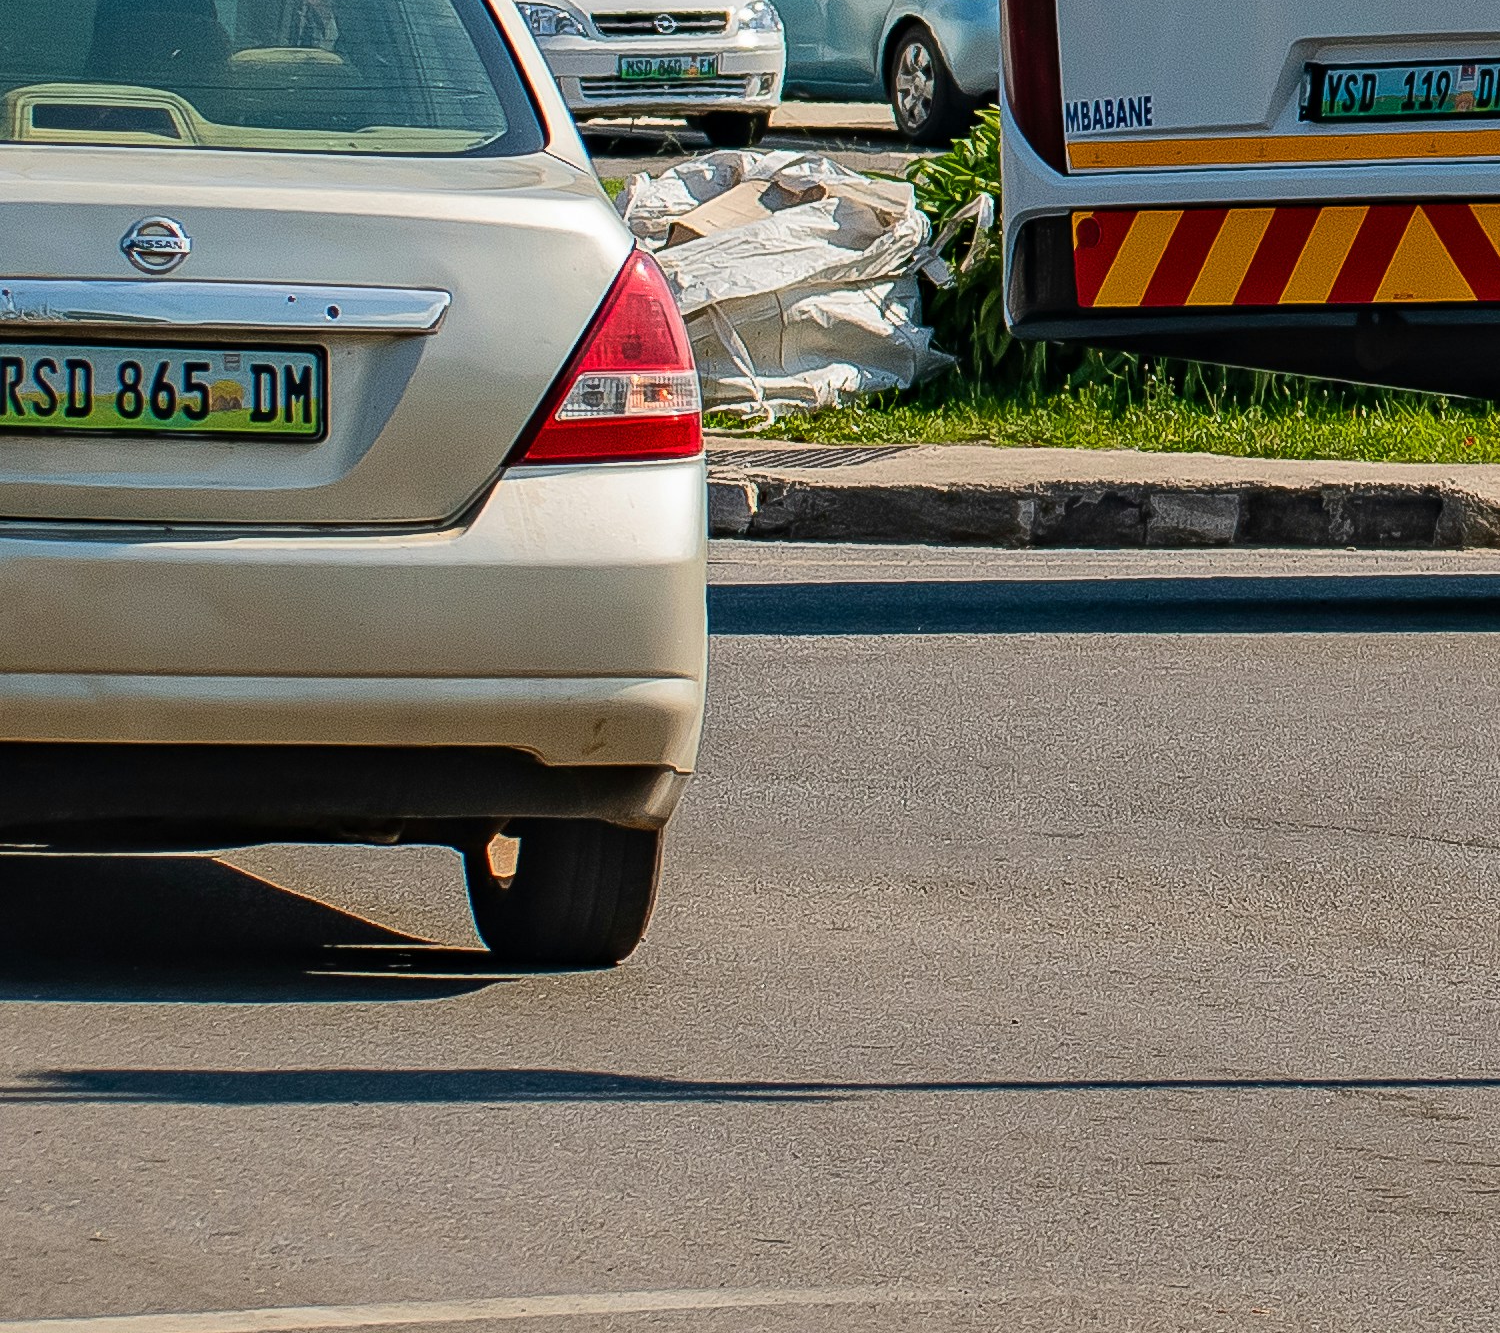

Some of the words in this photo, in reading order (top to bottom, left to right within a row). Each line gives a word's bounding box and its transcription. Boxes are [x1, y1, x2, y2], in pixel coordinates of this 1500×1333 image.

[1064, 95, 1153, 133] MBABANE
[1327, 73, 1378, 117] YSD
[1401, 69, 1452, 111] 119
[0, 356, 94, 418] RSD
[115, 360, 211, 421] 865
[250, 364, 313, 424] DM
